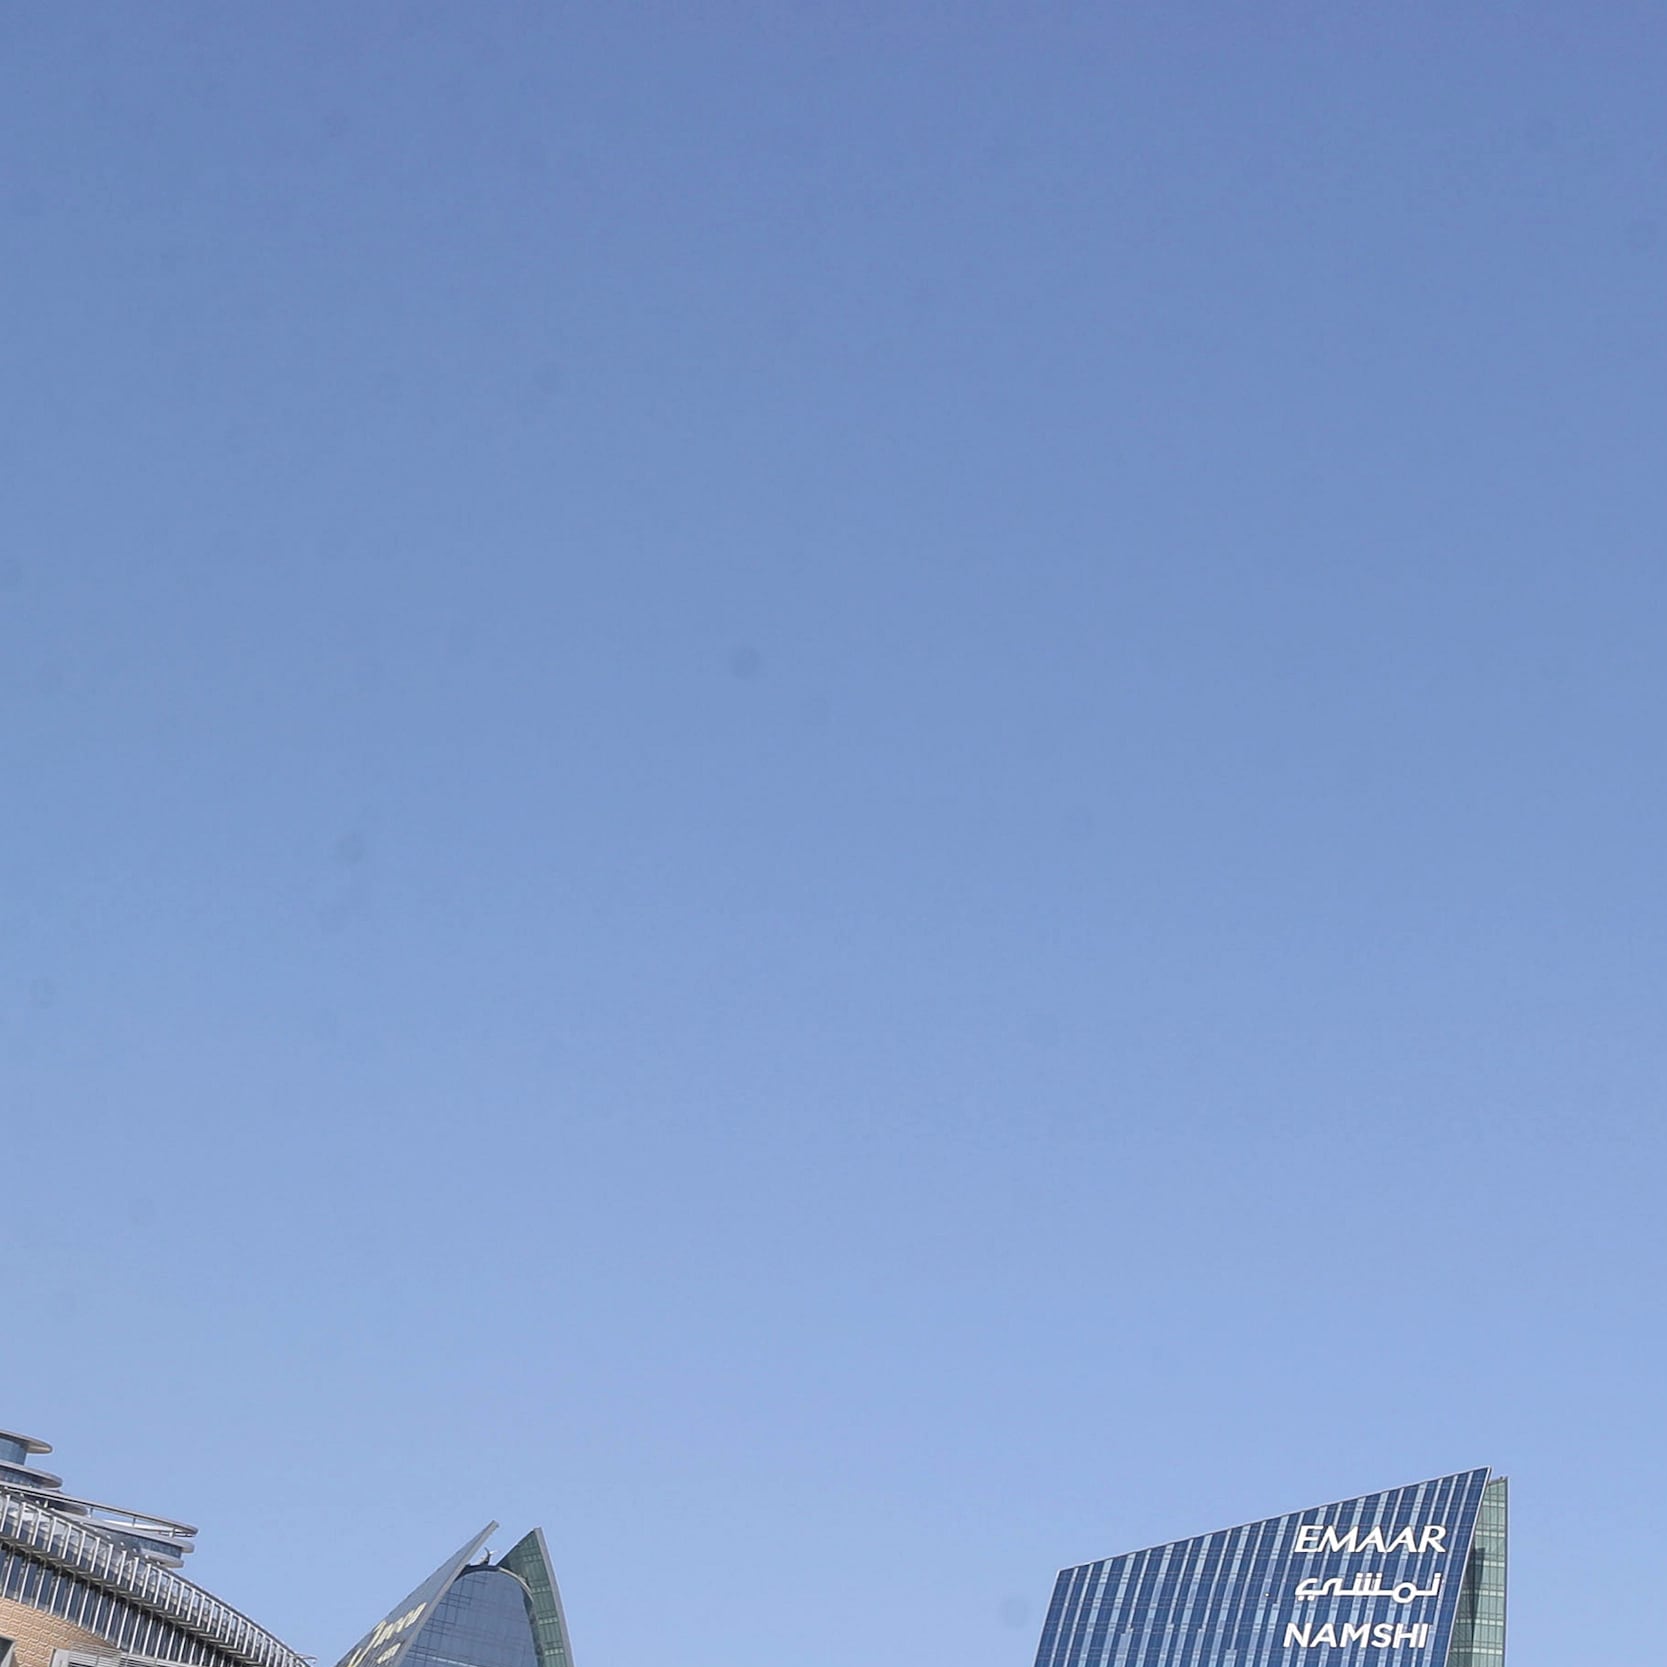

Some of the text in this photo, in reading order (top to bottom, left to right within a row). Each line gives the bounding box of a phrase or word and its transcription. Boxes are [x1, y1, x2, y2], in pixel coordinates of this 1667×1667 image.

[1294, 1525, 1447, 1553] EMAAR
[1294, 1572, 1442, 1604] نمشي
[1283, 1623, 1429, 1649] NAMSHI
